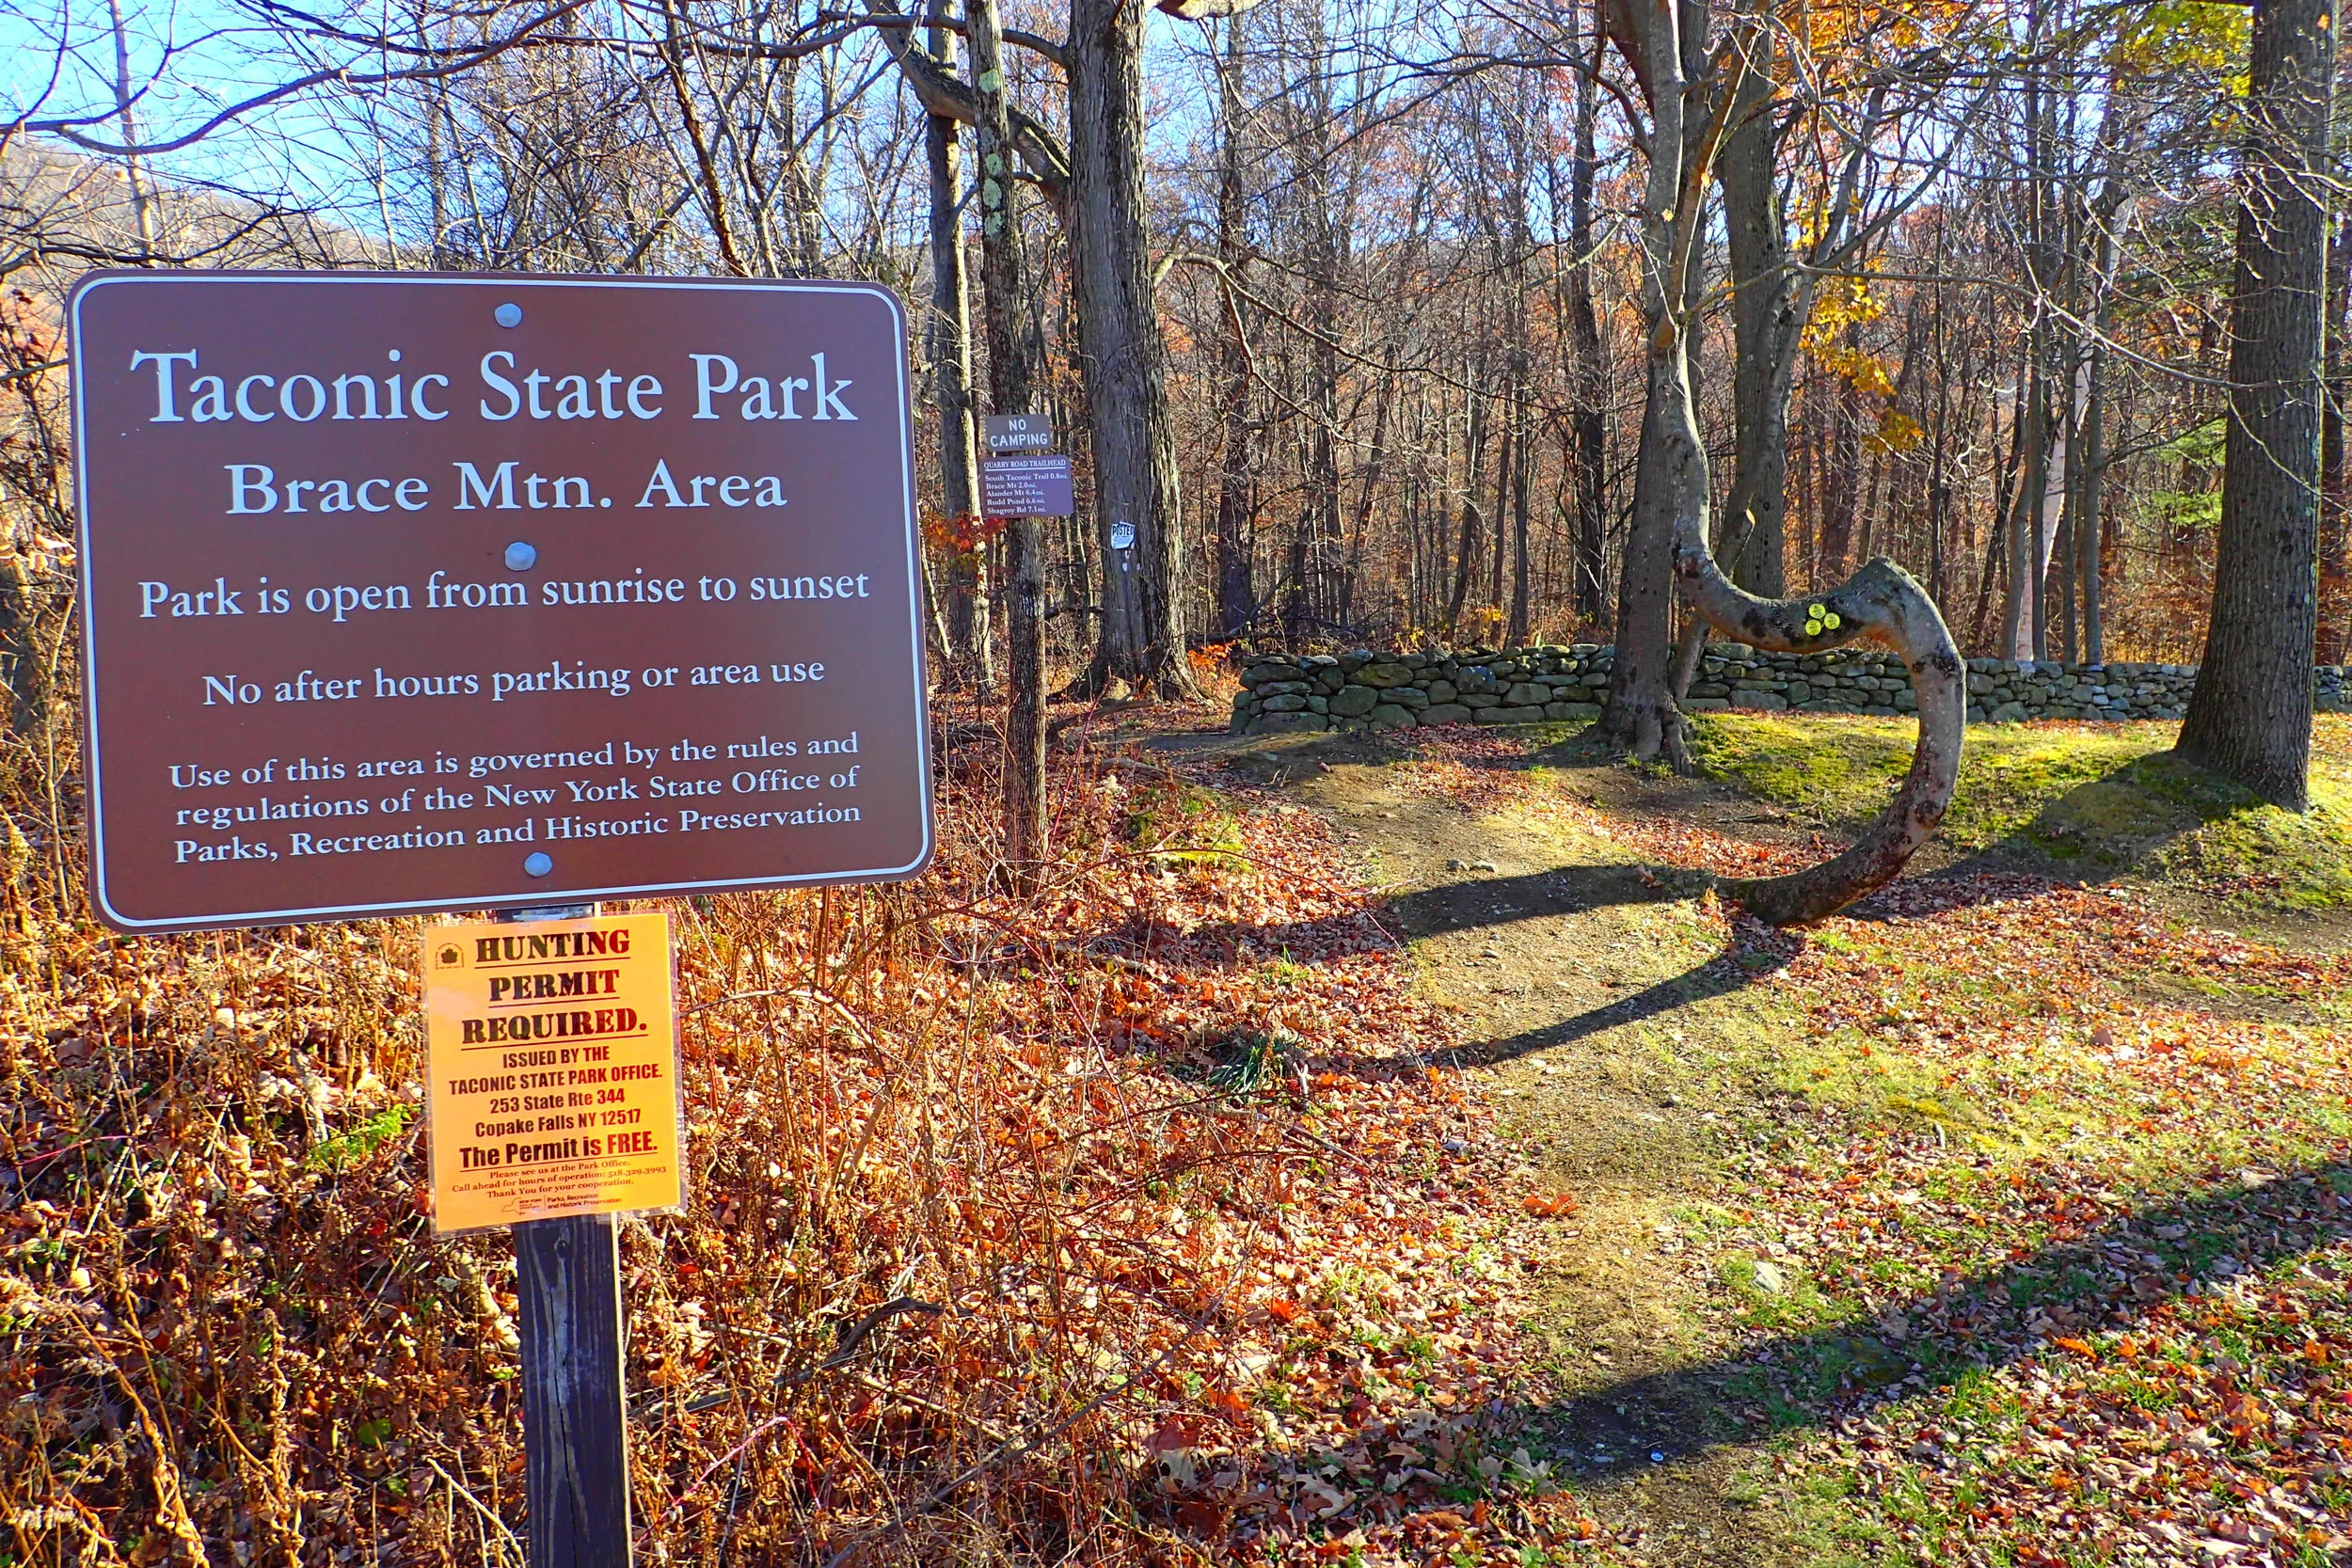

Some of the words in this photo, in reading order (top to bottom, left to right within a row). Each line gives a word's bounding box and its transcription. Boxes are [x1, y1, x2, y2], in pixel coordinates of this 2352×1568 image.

[131, 349, 448, 421] Taconic
[481, 352, 661, 420] State
[690, 353, 858, 420] Park
[991, 434, 1047, 447] CAMPING
[1009, 420, 1026, 431] NO
[984, 461, 1009, 469] QUARRY
[225, 465, 427, 514] Brace
[453, 462, 611, 509] Mtn.
[635, 459, 787, 507] Area
[139, 578, 244, 617] Park
[259, 578, 289, 612] is
[307, 586, 411, 621] open
[427, 571, 528, 607] from
[543, 579, 684, 605] sunrise
[699, 577, 736, 600] to
[751, 574, 868, 599] sunset
[203, 675, 261, 705] No
[275, 671, 361, 702] after
[374, 668, 478, 697] hours
[492, 661, 630, 701] parking
[643, 668, 678, 687] or
[691, 666, 760, 685] area
[771, 663, 824, 682] use
[169, 765, 230, 787] Use
[242, 759, 278, 784] of
[286, 757, 344, 781] this
[358, 761, 424, 777] area
[436, 752, 457, 772] is
[469, 743, 613, 777] governed
[625, 742, 659, 768] by
[671, 739, 716, 760] the
[728, 736, 796, 758] rules
[808, 732, 858, 754] and
[177, 796, 368, 829] regulations
[381, 789, 415, 813] of
[424, 787, 472, 810] the
[485, 784, 556, 806] New
[565, 778, 639, 801] York
[650, 777, 721, 797] State
[733, 769, 819, 792] Office
[831, 766, 860, 787] of
[175, 836, 278, 863] Parks,
[290, 826, 465, 855] Recreation
[477, 818, 534, 844] and
[546, 813, 667, 839] Historic
[679, 802, 861, 831] Preservation
[476, 929, 629, 962] HUNTING
[489, 970, 619, 1001] PERMIT
[462, 1008, 646, 1044] REQUIRED.
[503, 1051, 556, 1069] ISSUED
[561, 1048, 580, 1064] BY
[583, 1046, 610, 1061] THE
[449, 1075, 516, 1095] TACONIC
[520, 1071, 564, 1089] STATE
[568, 1069, 607, 1085] PARK
[612, 1064, 662, 1081] OFFICE.
[490, 1097, 519, 1114] 253
[524, 1095, 564, 1111] State
[568, 1093, 593, 1106] Rte
[596, 1088, 625, 1103] 344
[476, 1119, 533, 1137] Copake
[538, 1116, 574, 1132] Falls
[579, 1113, 596, 1128] NY
[601, 1109, 641, 1125] 12517
[459, 1147, 500, 1168] The
[506, 1138, 579, 1164] Permit
[583, 1136, 601, 1156] is
[608, 1131, 657, 1157] FREE.
[453, 1184, 470, 1193] Call
[472, 1180, 501, 1190] ahead
[502, 1179, 516, 1187] for
[518, 1176, 546, 1185] hours
[559, 1172, 605, 1183] operation:
[608, 1166, 666, 1178] 518.329.3993
[579, 1162, 599, 1171] Park
[487, 1189, 516, 1198] Thank
[554, 1183, 576, 1193] your
[579, 1179, 634, 1191] cooperation.
